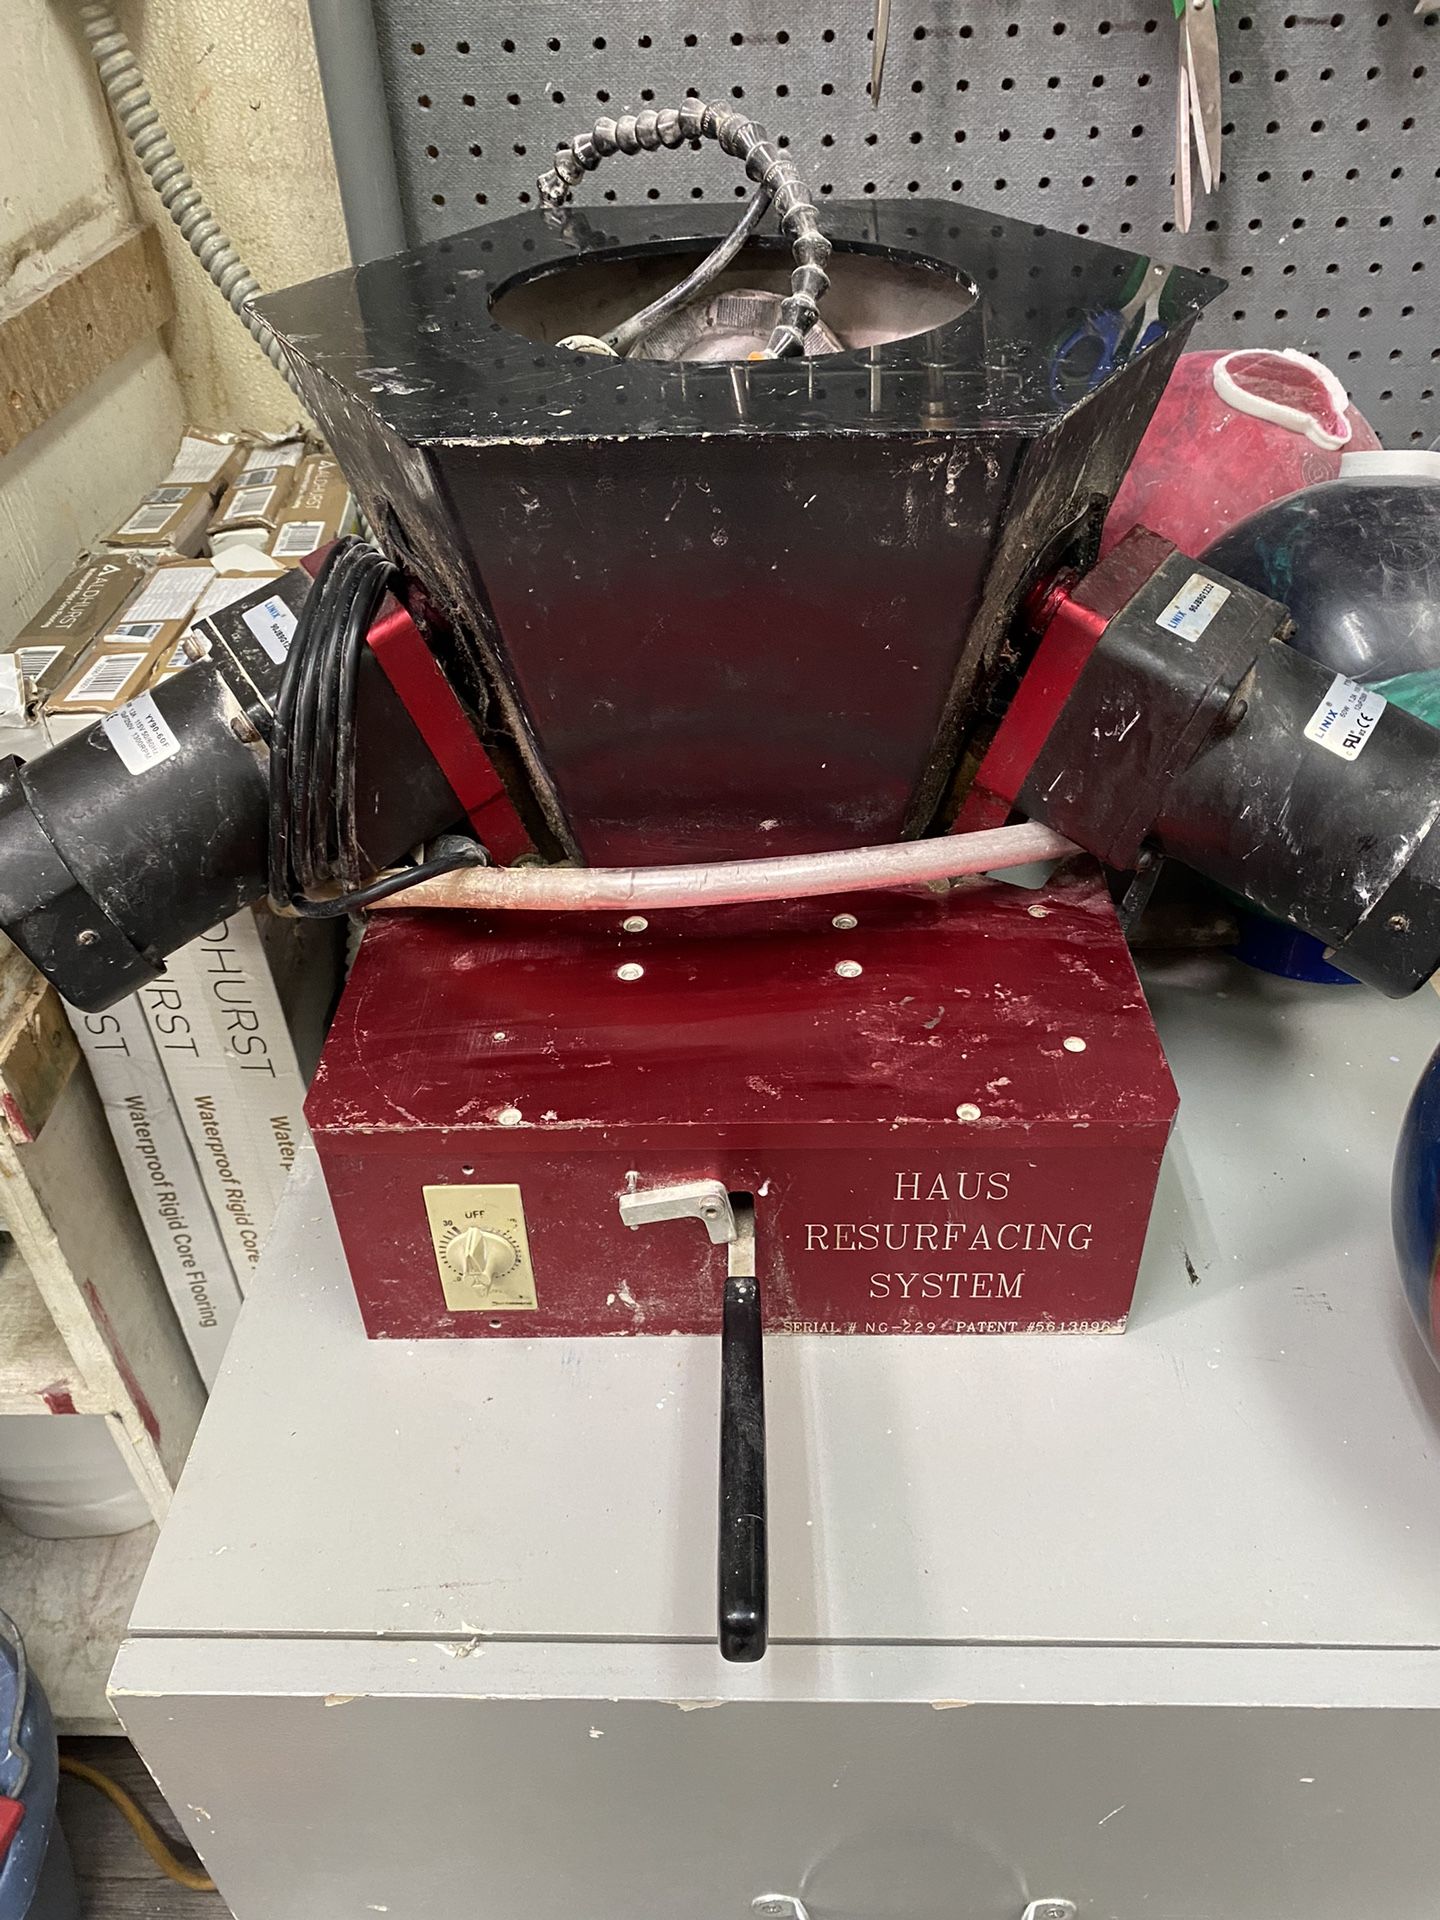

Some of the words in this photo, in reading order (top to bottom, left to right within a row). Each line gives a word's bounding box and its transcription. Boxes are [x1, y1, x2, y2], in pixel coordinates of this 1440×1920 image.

[56, 576, 108, 629] ALDHURST
[264, 601, 280, 618] LINIX
[1167, 610, 1186, 629] LINIX
[1314, 709, 1337, 739] LINIX
[194, 1095, 241, 1185] Waterproof
[893, 1172, 1011, 1201] HAUS
[125, 1095, 174, 1188] Waterproof
[157, 1191, 188, 1231] Rigid
[173, 1233, 196, 1268] Core
[186, 1271, 217, 1328] Flooring
[225, 1188, 254, 1226] Rigid
[239, 1230, 260, 1264] Core
[804, 1223, 1093, 1251] RESURFACING
[869, 1273, 1025, 1298] SYSTEM
[783, 1321, 840, 1333] SERIAL
[865, 1321, 936, 1333] NG-229
[956, 1321, 1018, 1333] PATENT
